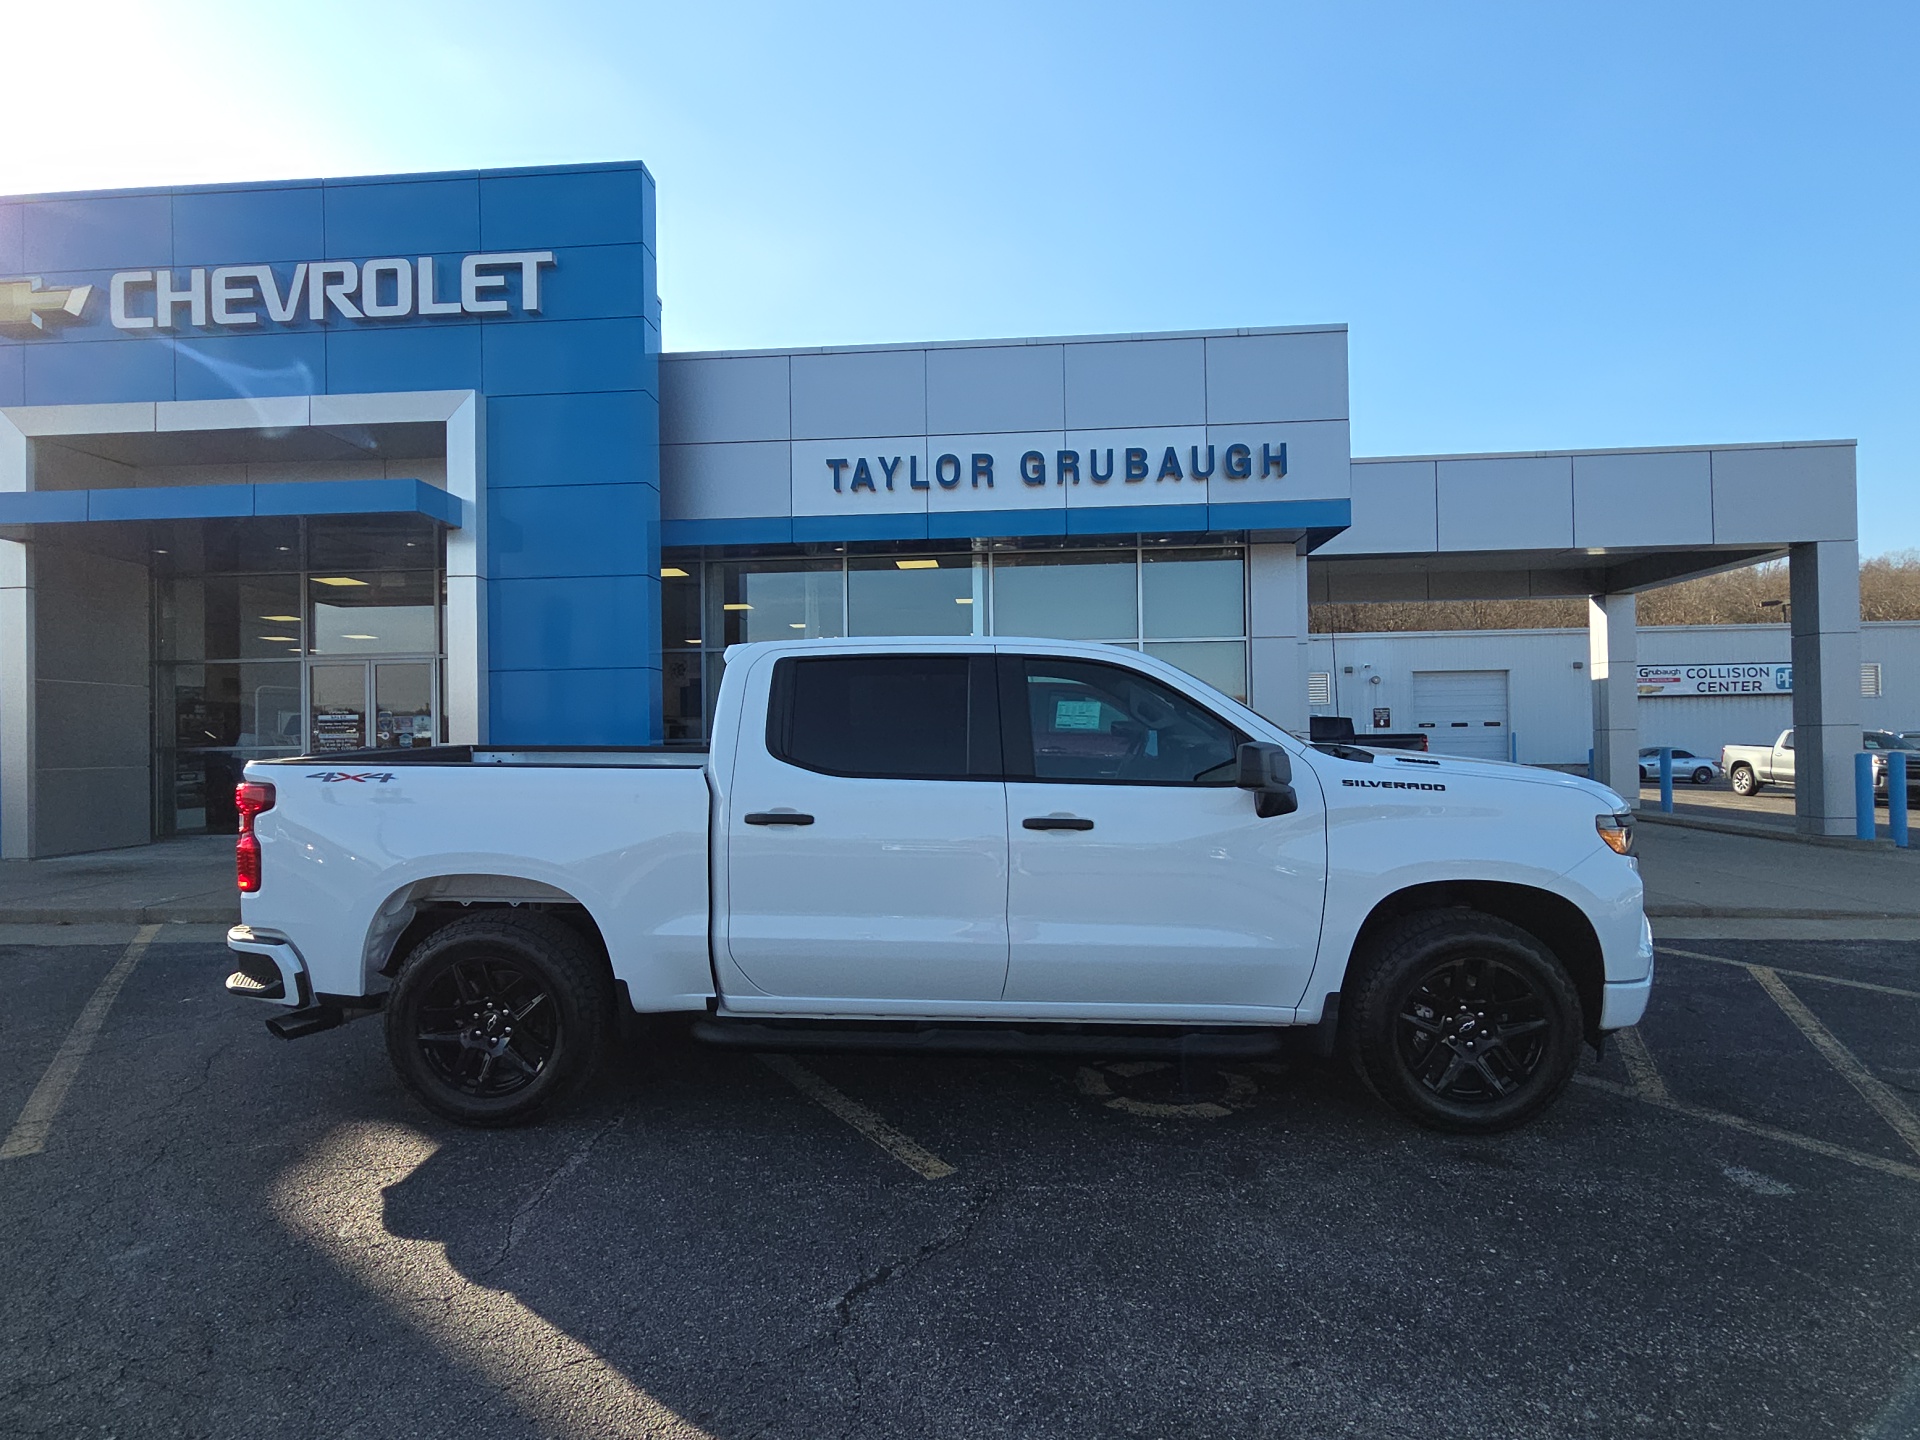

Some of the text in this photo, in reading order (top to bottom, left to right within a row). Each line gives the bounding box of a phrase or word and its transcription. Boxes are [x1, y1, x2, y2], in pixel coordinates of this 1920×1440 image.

[110, 250, 556, 330] CHEVROLET
[826, 442, 1288, 493] TAYLOR GRUBAUGH
[1639, 668, 1682, 677] Grubaugh
[1686, 667, 1770, 679] COLLISION
[1696, 681, 1763, 693] CENTER
[1341, 779, 1446, 791] SILVERADO
